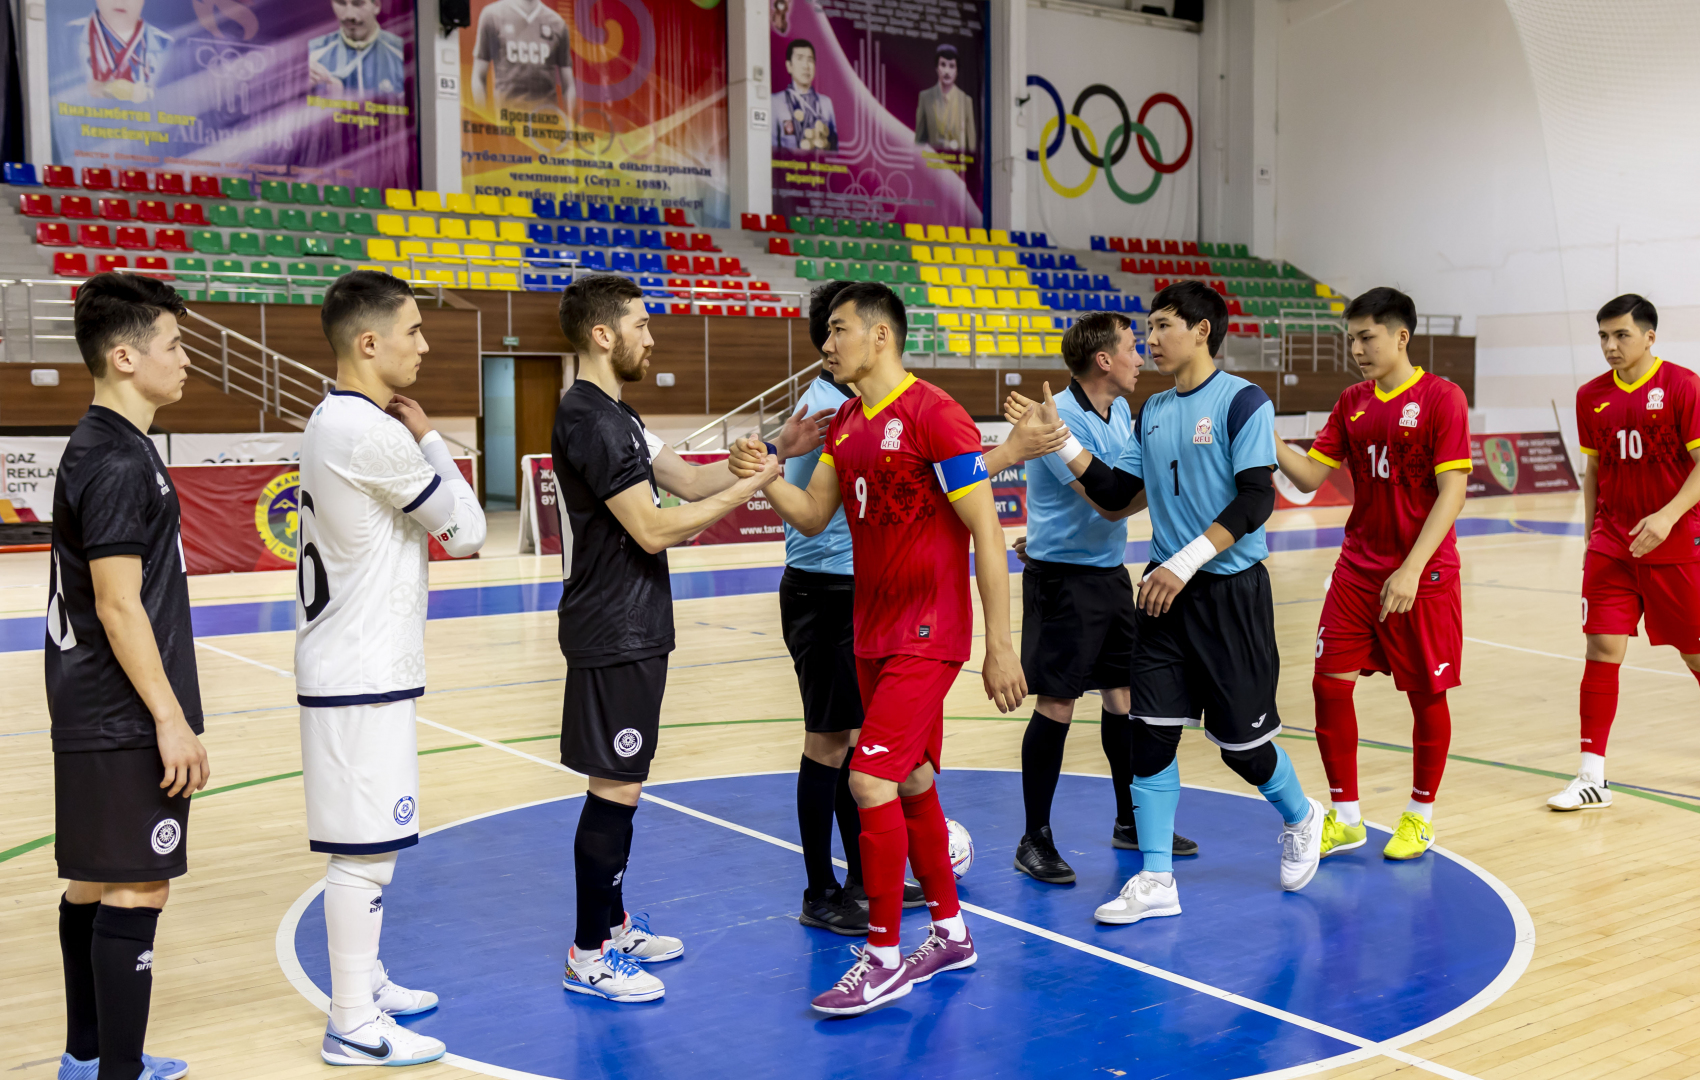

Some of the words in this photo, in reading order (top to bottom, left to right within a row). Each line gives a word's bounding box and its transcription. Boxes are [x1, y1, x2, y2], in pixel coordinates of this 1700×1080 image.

[506, 41, 551, 64] СССР
[440, 78, 456, 89] B3
[500, 107, 559, 125] Яровенко
[754, 111, 766, 121] B2
[462, 119, 516, 137] Евгений
[523, 124, 596, 143] Викторович
[538, 154, 614, 170] Олимпиада
[509, 172, 579, 184] чемпионы
[881, 440, 899, 449] KFU
[982, 435, 999, 443] QAZ
[1194, 435, 1211, 443] KFU
[1616, 430, 1643, 459] 10
[6, 453, 35, 464] QAZ
[1367, 444, 1390, 479] 16
[7, 468, 59, 478] REKLA
[1170, 459, 1180, 496] 1
[7, 482, 38, 493] CITY
[855, 476, 867, 519] 9
